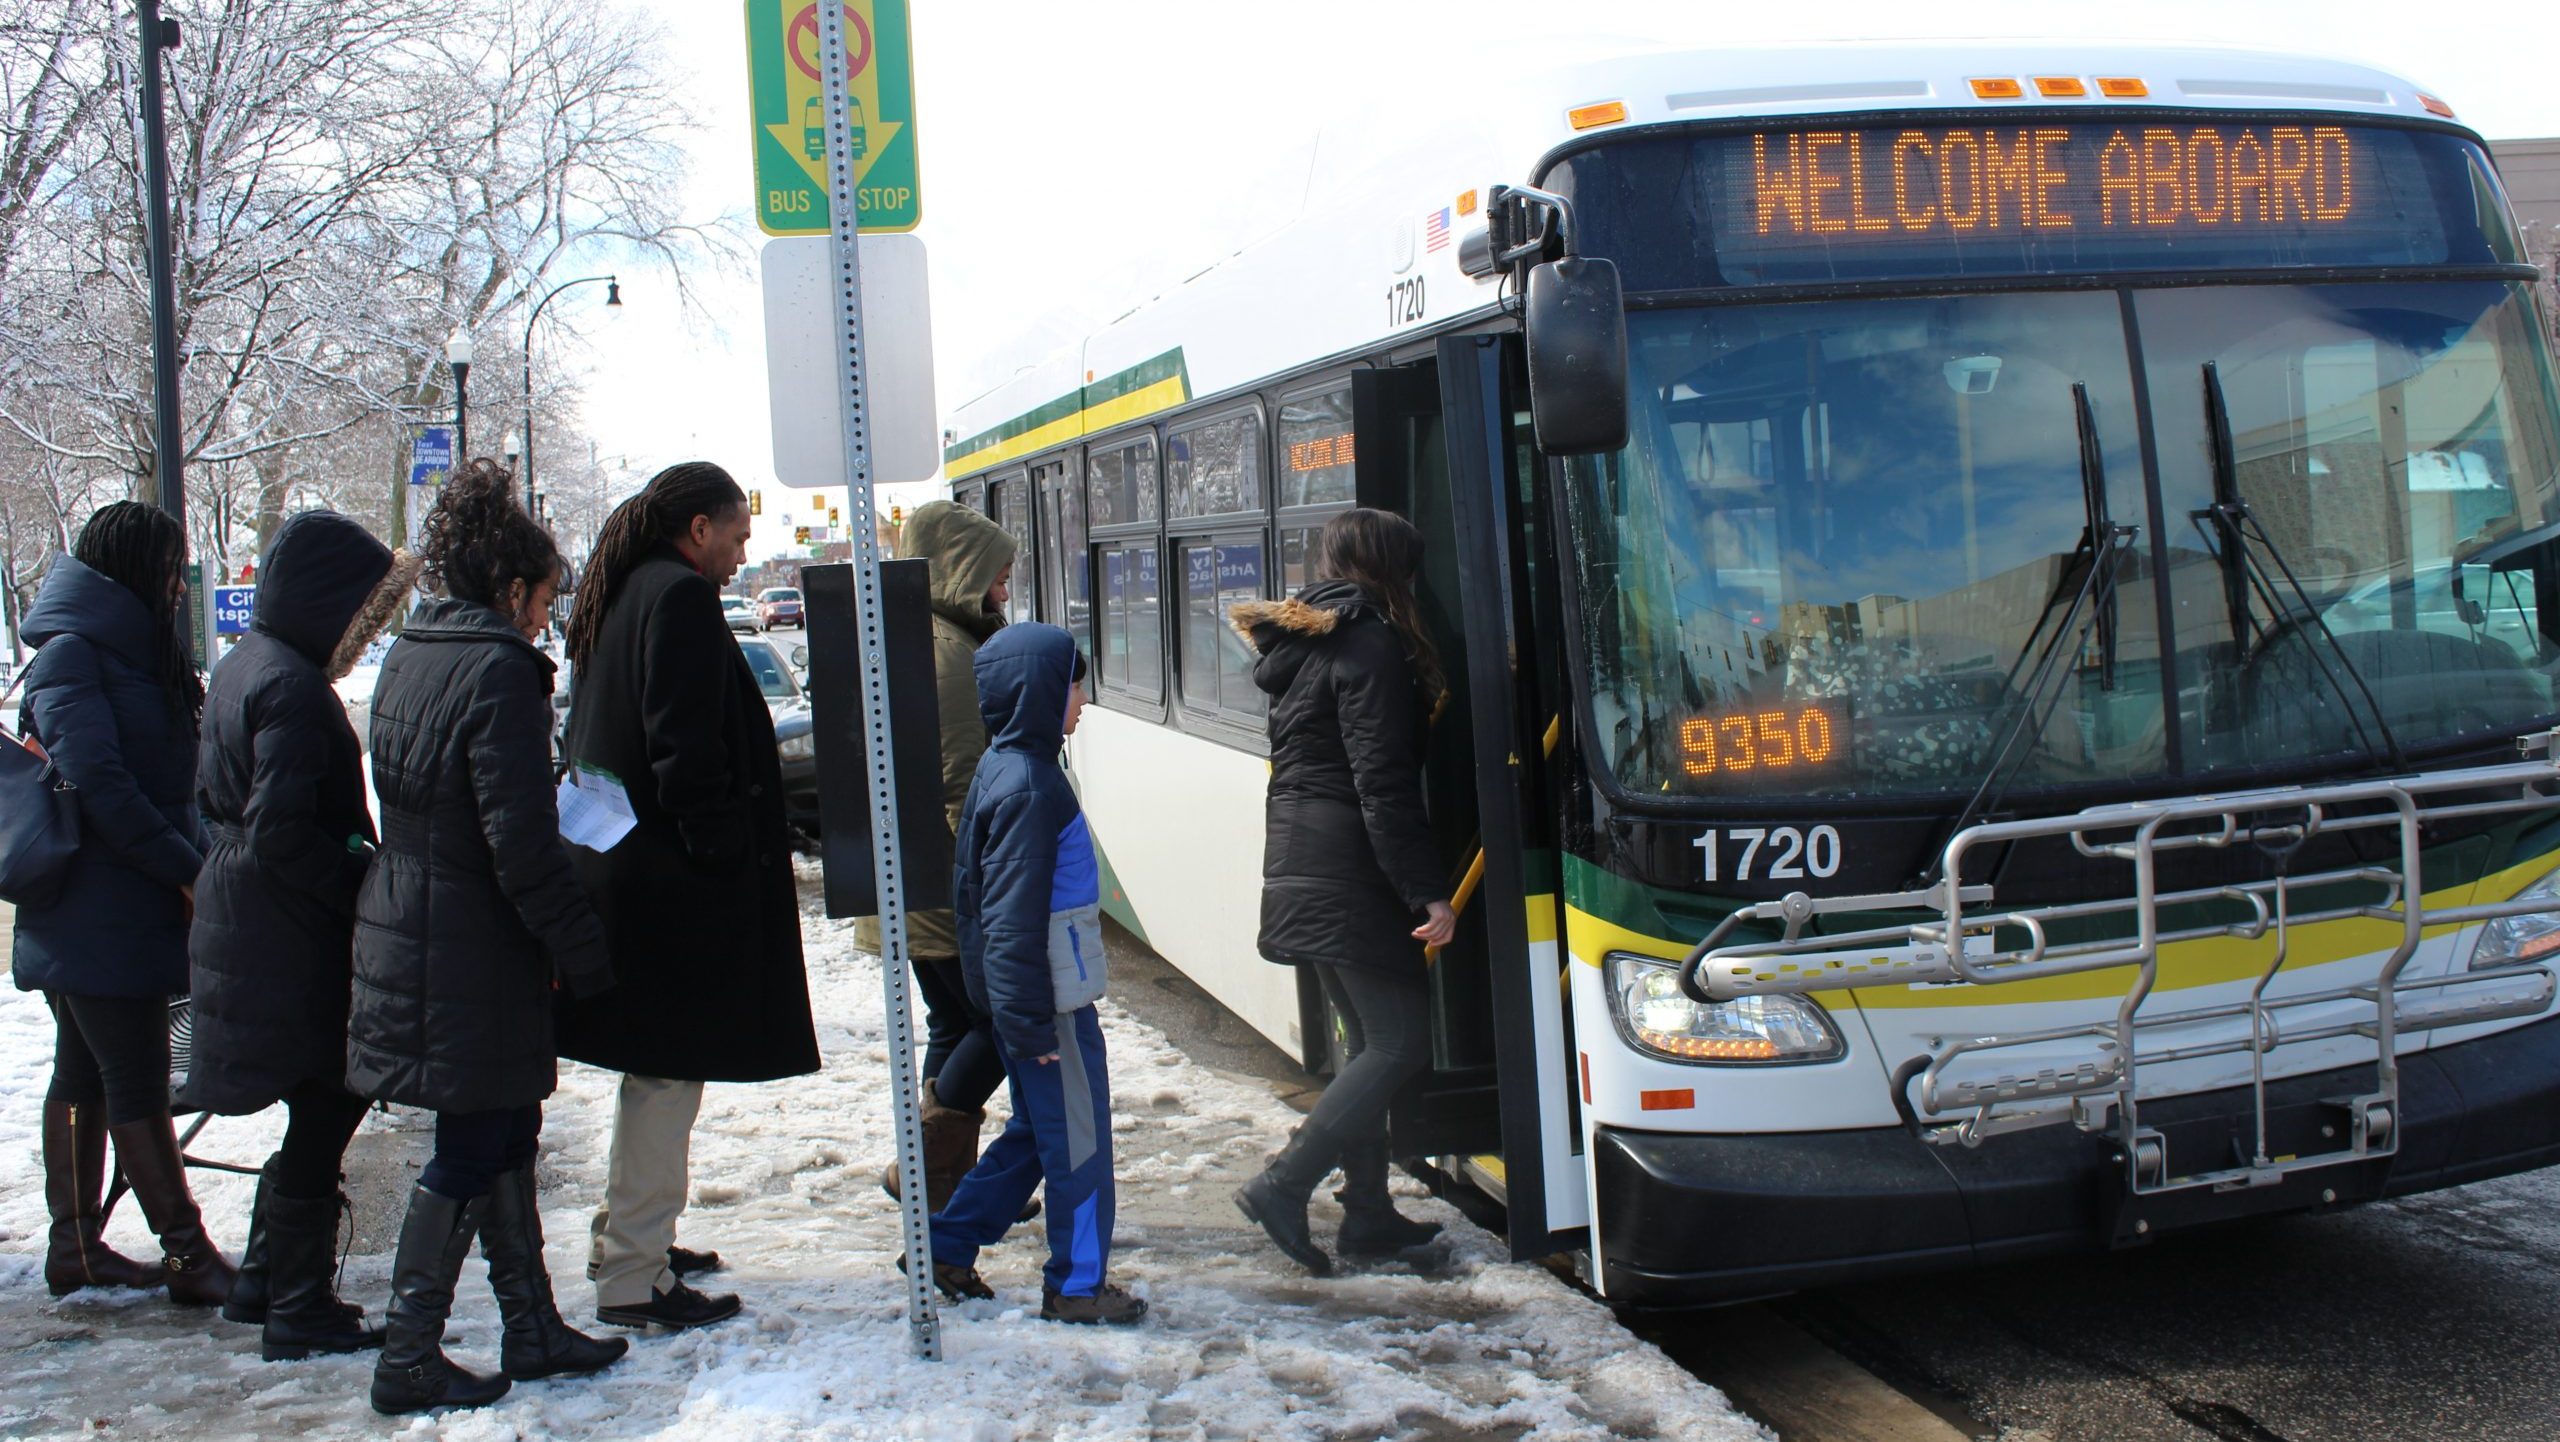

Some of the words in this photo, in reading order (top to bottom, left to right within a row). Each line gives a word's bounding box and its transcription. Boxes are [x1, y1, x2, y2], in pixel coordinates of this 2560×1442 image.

[769, 190, 811, 213] BUS
[858, 187, 911, 211] STOP
[1754, 130, 2072, 233] WELCOME
[2099, 126, 2352, 226] ABOARD
[1387, 274, 1425, 328] 1720
[415, 448, 450, 456] DOWNTOWN
[415, 456, 450, 465] DEARBORN
[1682, 708, 1831, 774] 9350
[1693, 824, 1841, 881] 1720
